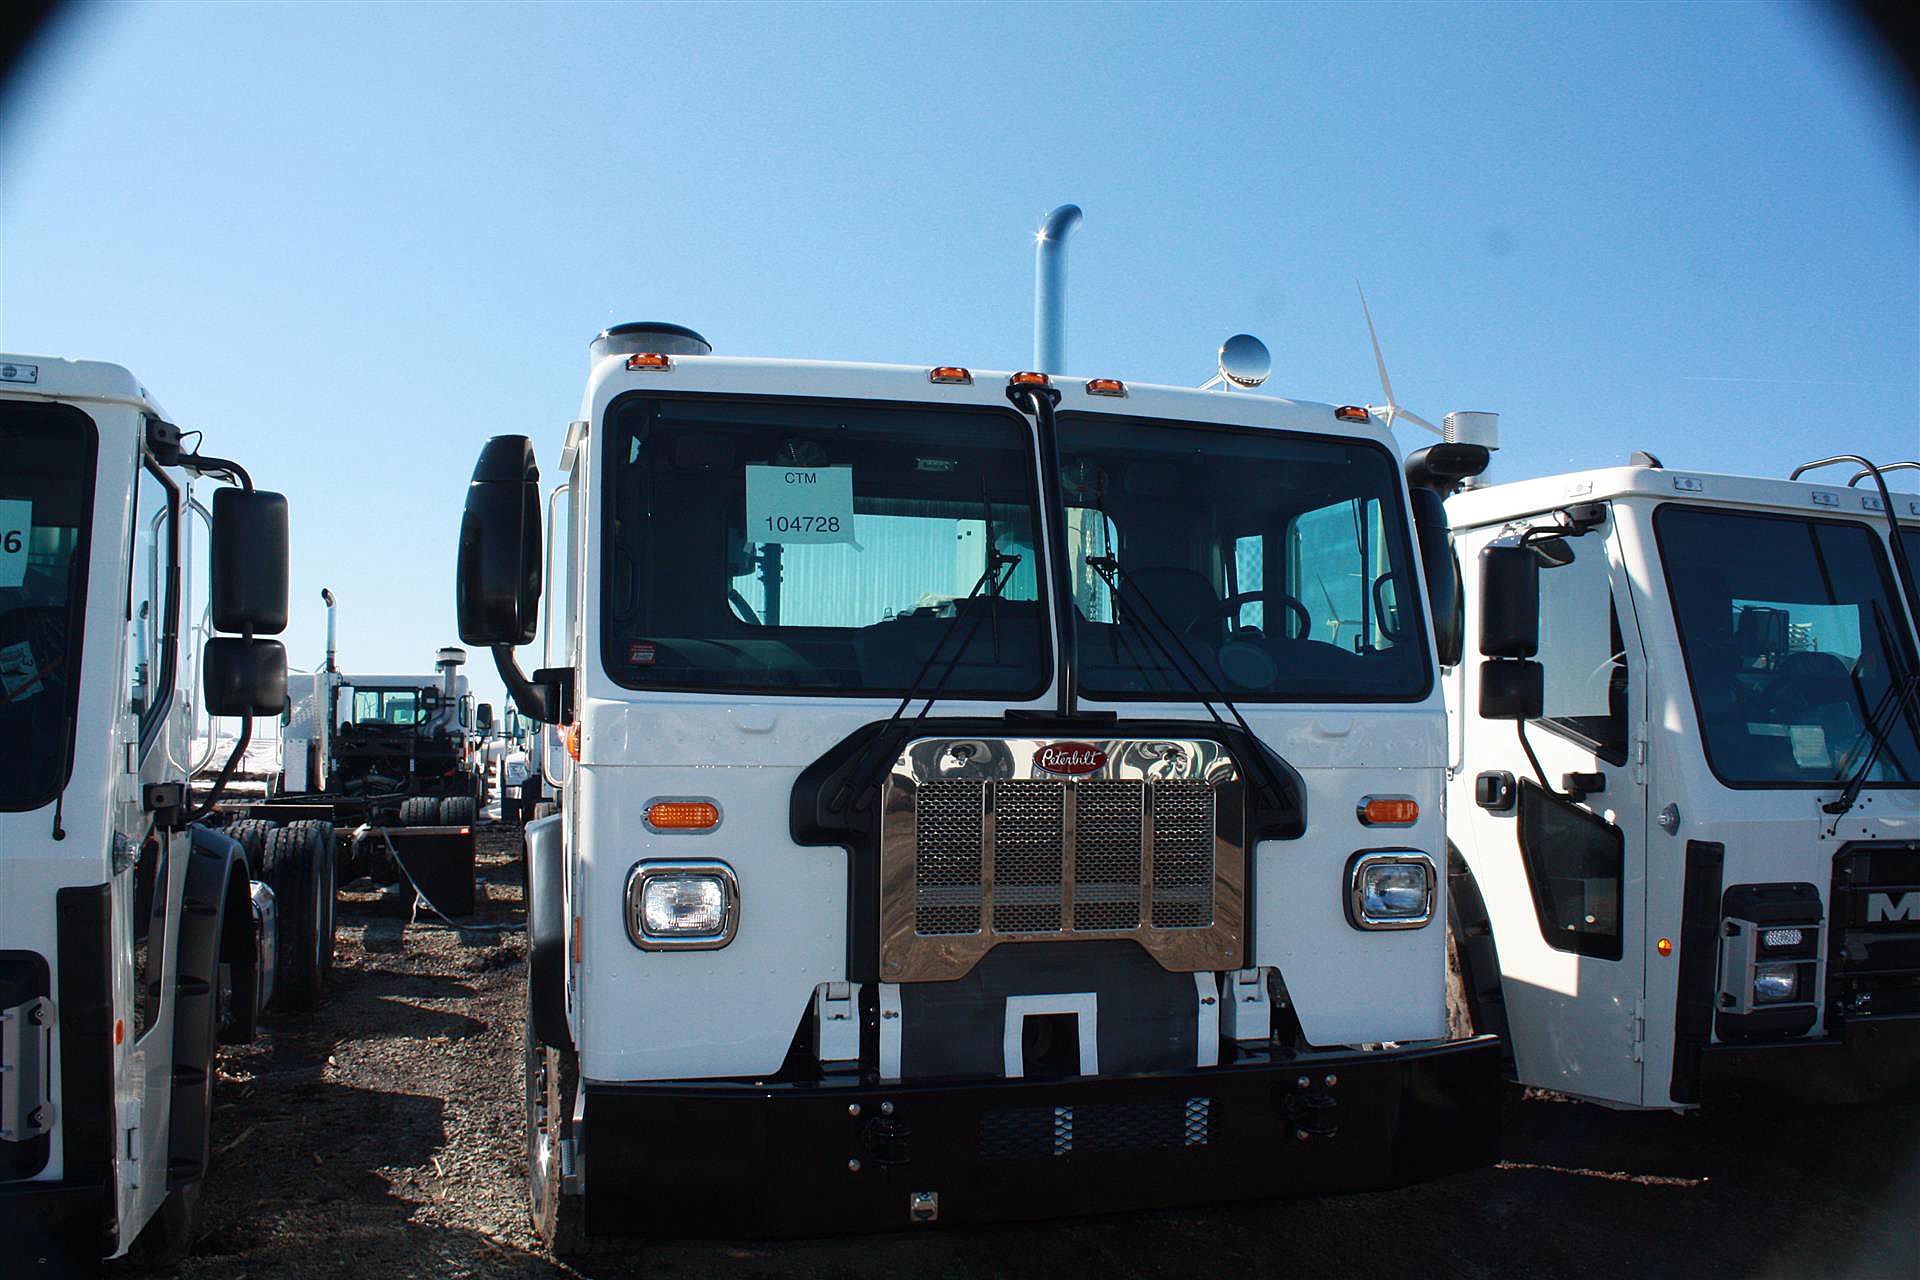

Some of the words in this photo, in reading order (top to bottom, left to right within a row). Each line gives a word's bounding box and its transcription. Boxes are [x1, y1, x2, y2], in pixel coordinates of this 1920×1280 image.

[785, 472, 817, 484] CTM
[765, 516, 840, 532] 104728
[0, 530, 22, 553] 6
[1041, 748, 1102, 767] Peterbilt
